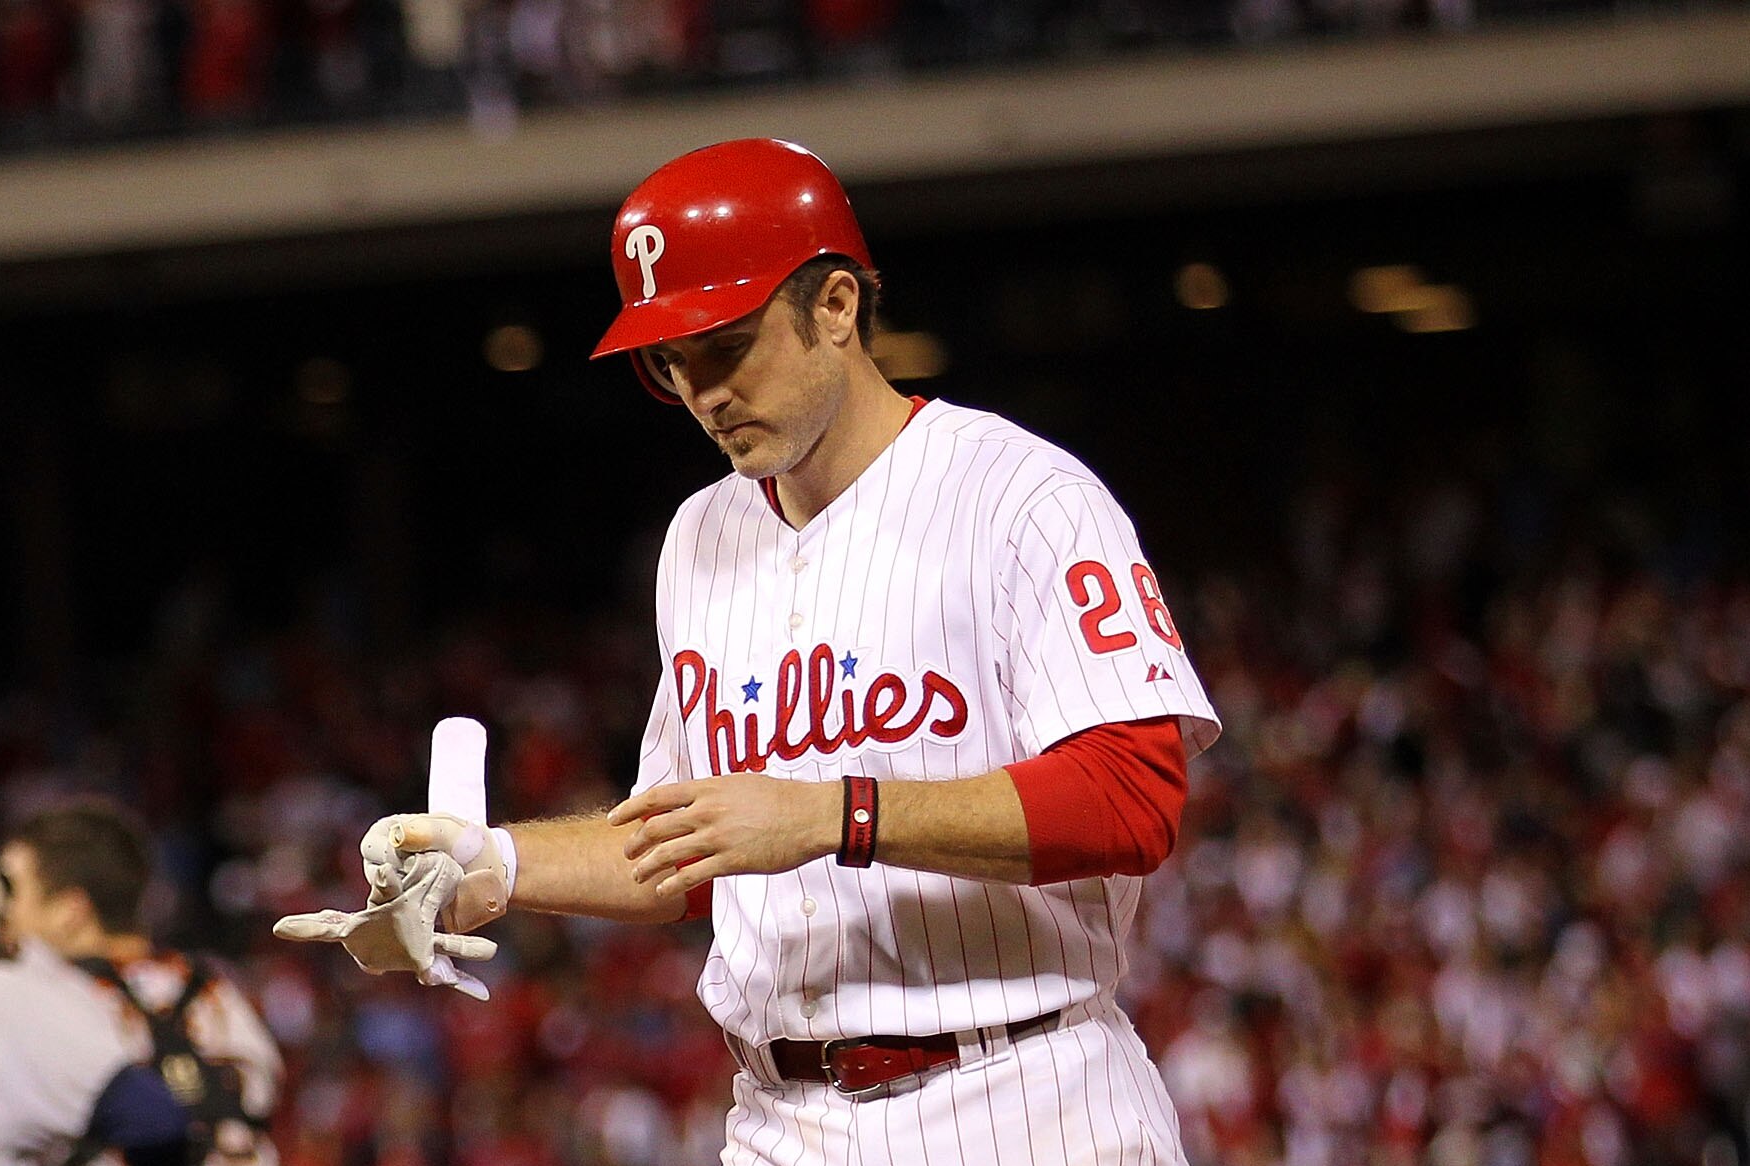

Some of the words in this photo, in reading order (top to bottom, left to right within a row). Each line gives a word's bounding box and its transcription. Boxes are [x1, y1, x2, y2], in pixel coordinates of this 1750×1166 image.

[625, 224, 665, 299] P
[1064, 559, 1184, 655] 26
[673, 642, 969, 776] Phillies
